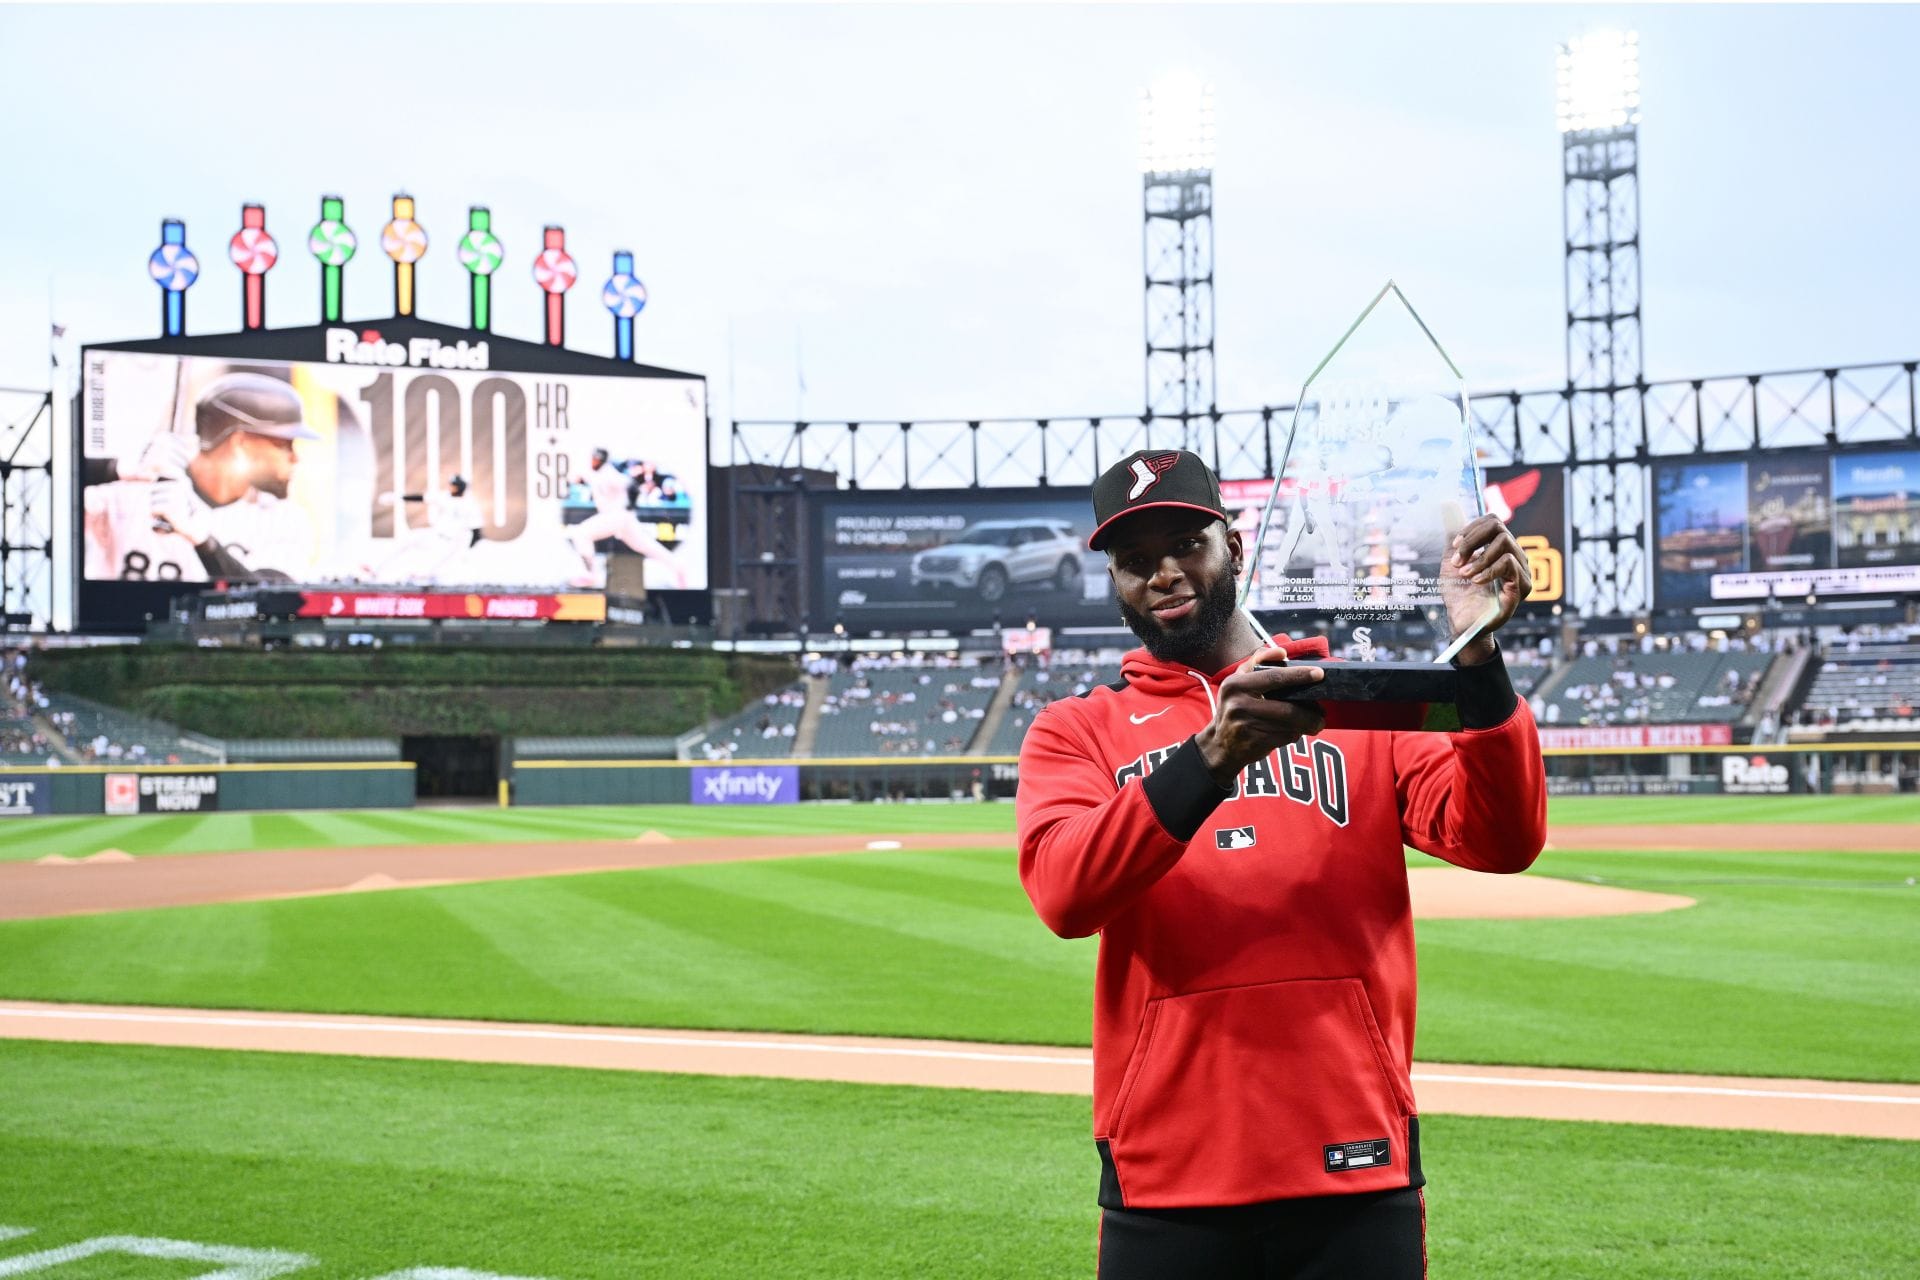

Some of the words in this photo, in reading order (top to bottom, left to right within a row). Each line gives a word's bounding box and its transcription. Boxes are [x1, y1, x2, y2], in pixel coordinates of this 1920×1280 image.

[326, 328, 407, 366] Rate
[409, 338, 489, 369] Field
[536, 383, 569, 429] HR
[360, 372, 527, 541] 100
[537, 453, 569, 499] SB
[836, 516, 893, 530] PROUDLY
[894, 516, 965, 530] ASSEMBLED
[355, 597, 397, 616] WHITE
[397, 598, 426, 616] SOX
[486, 598, 538, 618] PADRES
[1650, 725, 1702, 746] MEATS
[140, 776, 216, 795] STREAM
[704, 770, 783, 801] xfinity
[1115, 734, 1349, 828] CAGO
[1723, 756, 1789, 785] Rate
[157, 793, 201, 810] NOW
